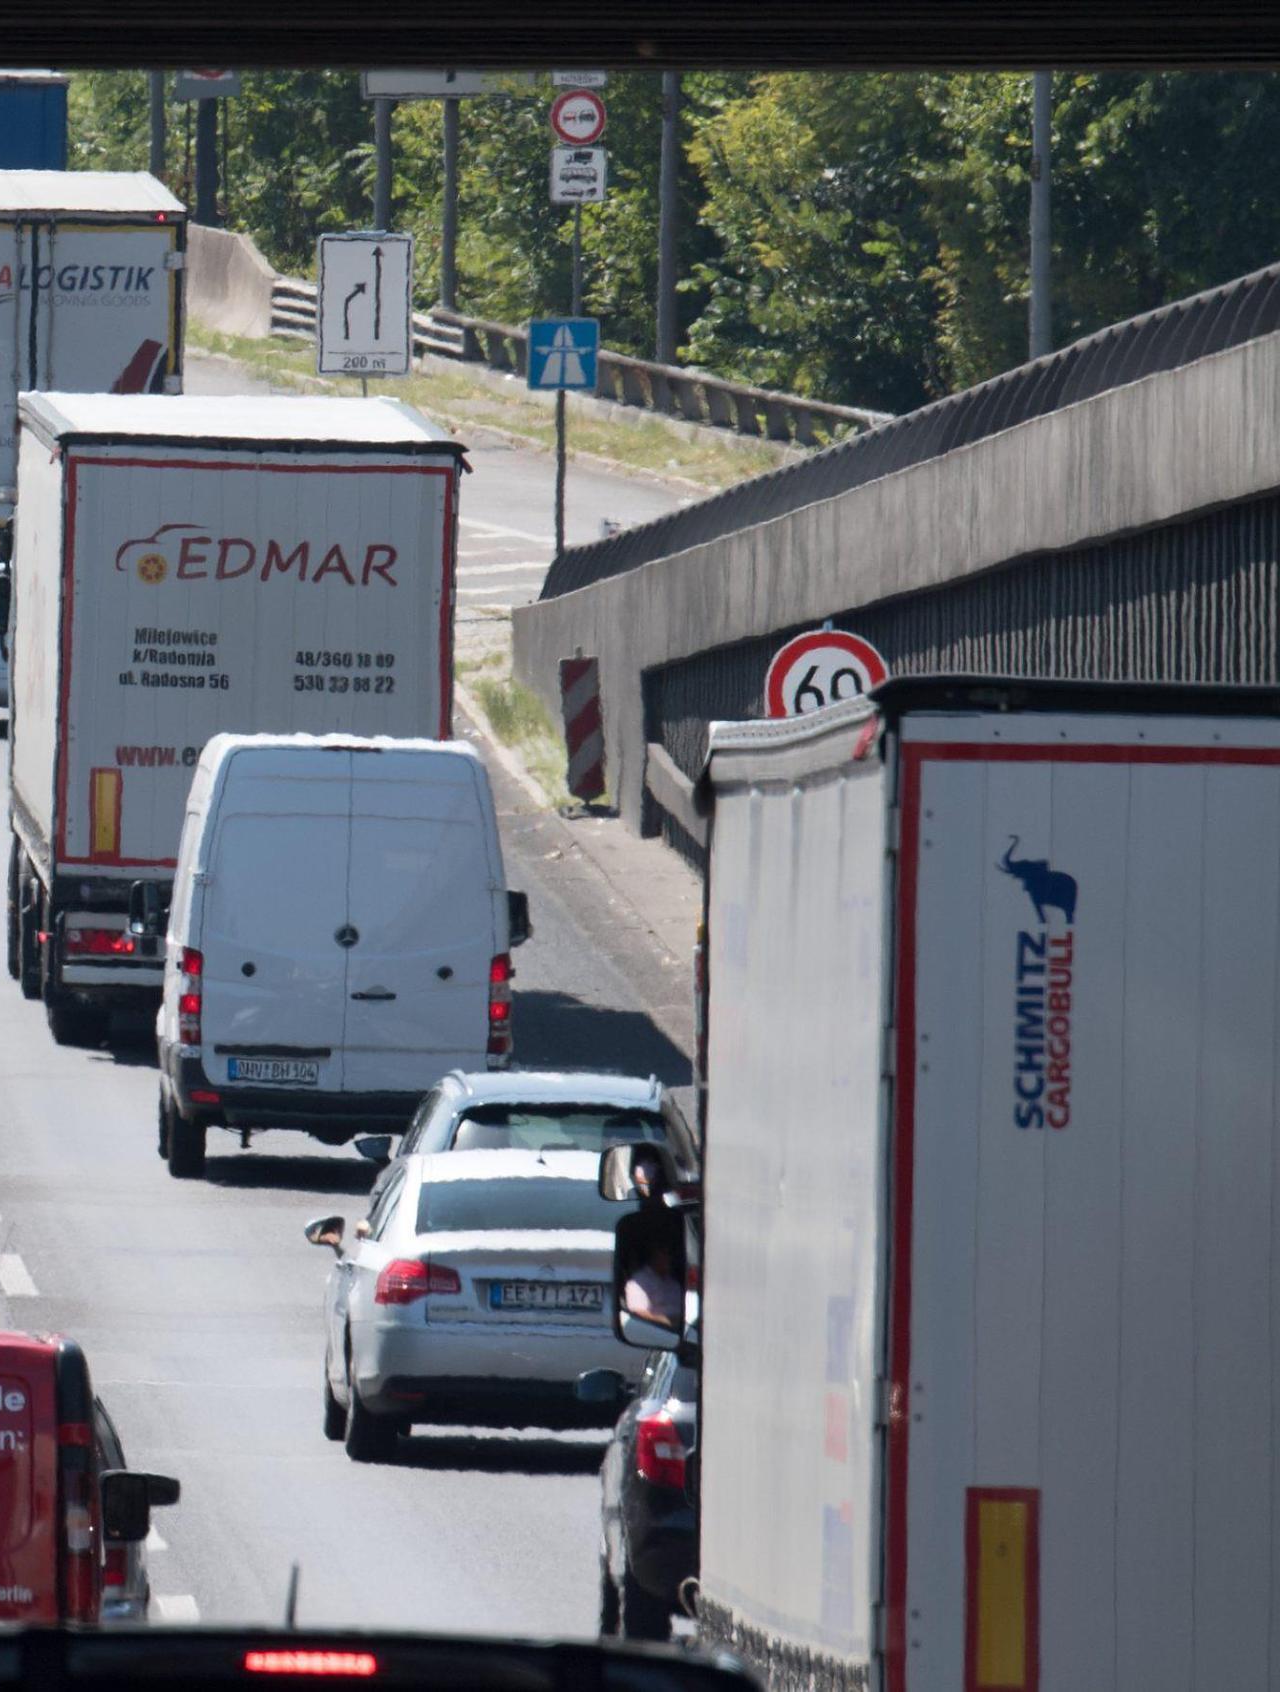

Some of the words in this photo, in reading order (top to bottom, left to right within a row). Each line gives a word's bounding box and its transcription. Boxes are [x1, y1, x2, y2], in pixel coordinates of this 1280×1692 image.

[101, 294, 151, 308] GOODS
[343, 356, 369, 369] 200
[372, 358, 386, 369] m
[176, 536, 399, 587] EDMAR
[134, 627, 218, 646] Milejowice
[132, 648, 216, 667] k/Radomia
[295, 651, 353, 668] 48/360
[141, 671, 205, 689] Radosna
[209, 673, 230, 690] 56
[294, 674, 325, 692] 530
[374, 675, 395, 694] 22
[795, 666, 863, 713] 60
[116, 745, 204, 767] www.e
[1014, 930, 1047, 1130] SCHMITZ
[1046, 931, 1073, 1130] CARGOBULL
